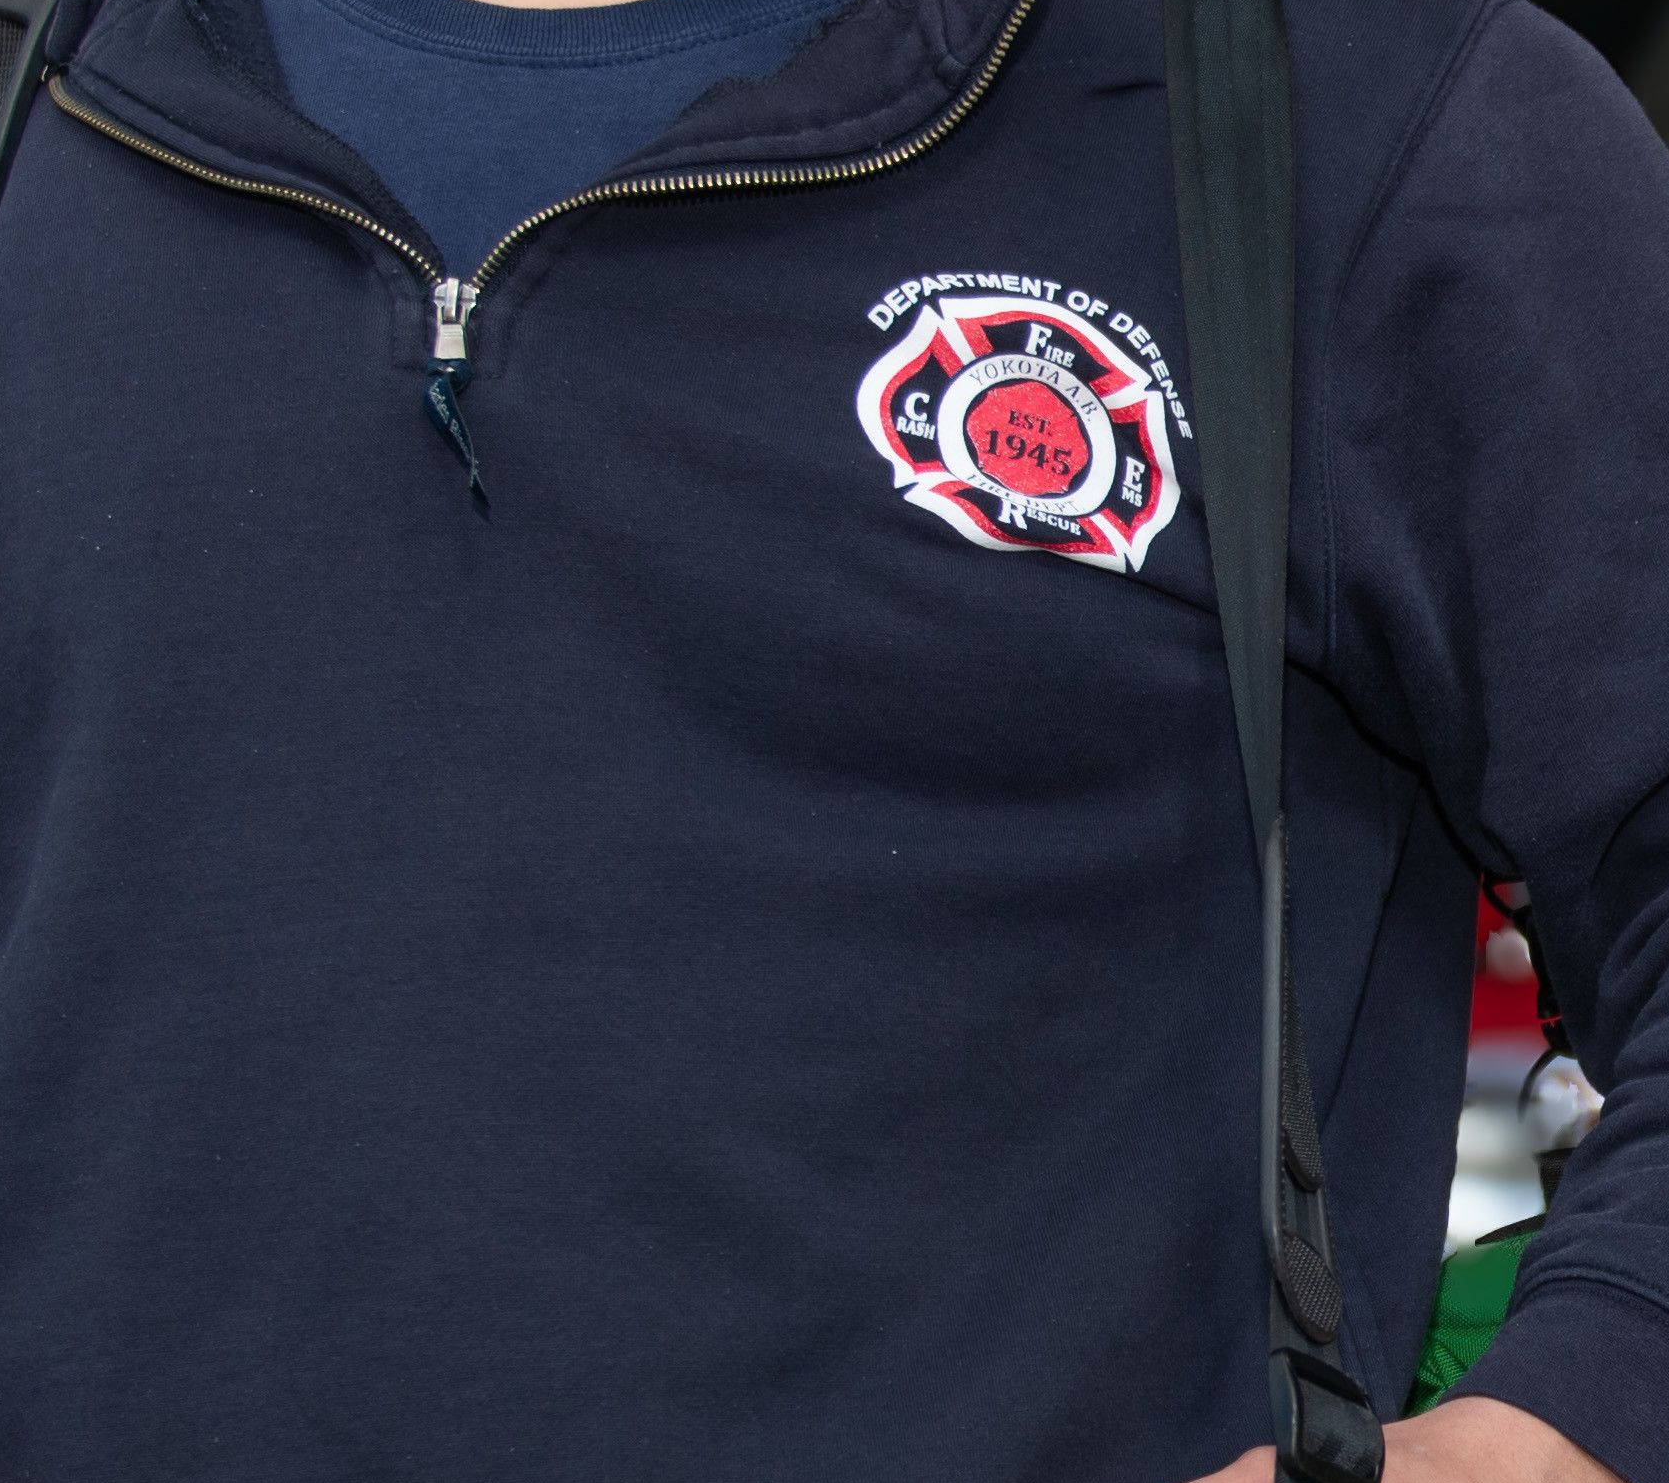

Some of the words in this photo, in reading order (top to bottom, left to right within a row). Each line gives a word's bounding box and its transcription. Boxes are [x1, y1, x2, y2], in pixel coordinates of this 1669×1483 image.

[868, 272, 1062, 332] DEPARTMENT
[1067, 289, 1109, 319] OF
[1108, 313, 1194, 440] DEFENSE
[1025, 322, 1076, 369] FIRE
[969, 359, 1060, 386] YOKOTA
[1008, 409, 1053, 437] EST.
[983, 429, 1073, 477] 1945
[998, 498, 1082, 536] RESCUE
